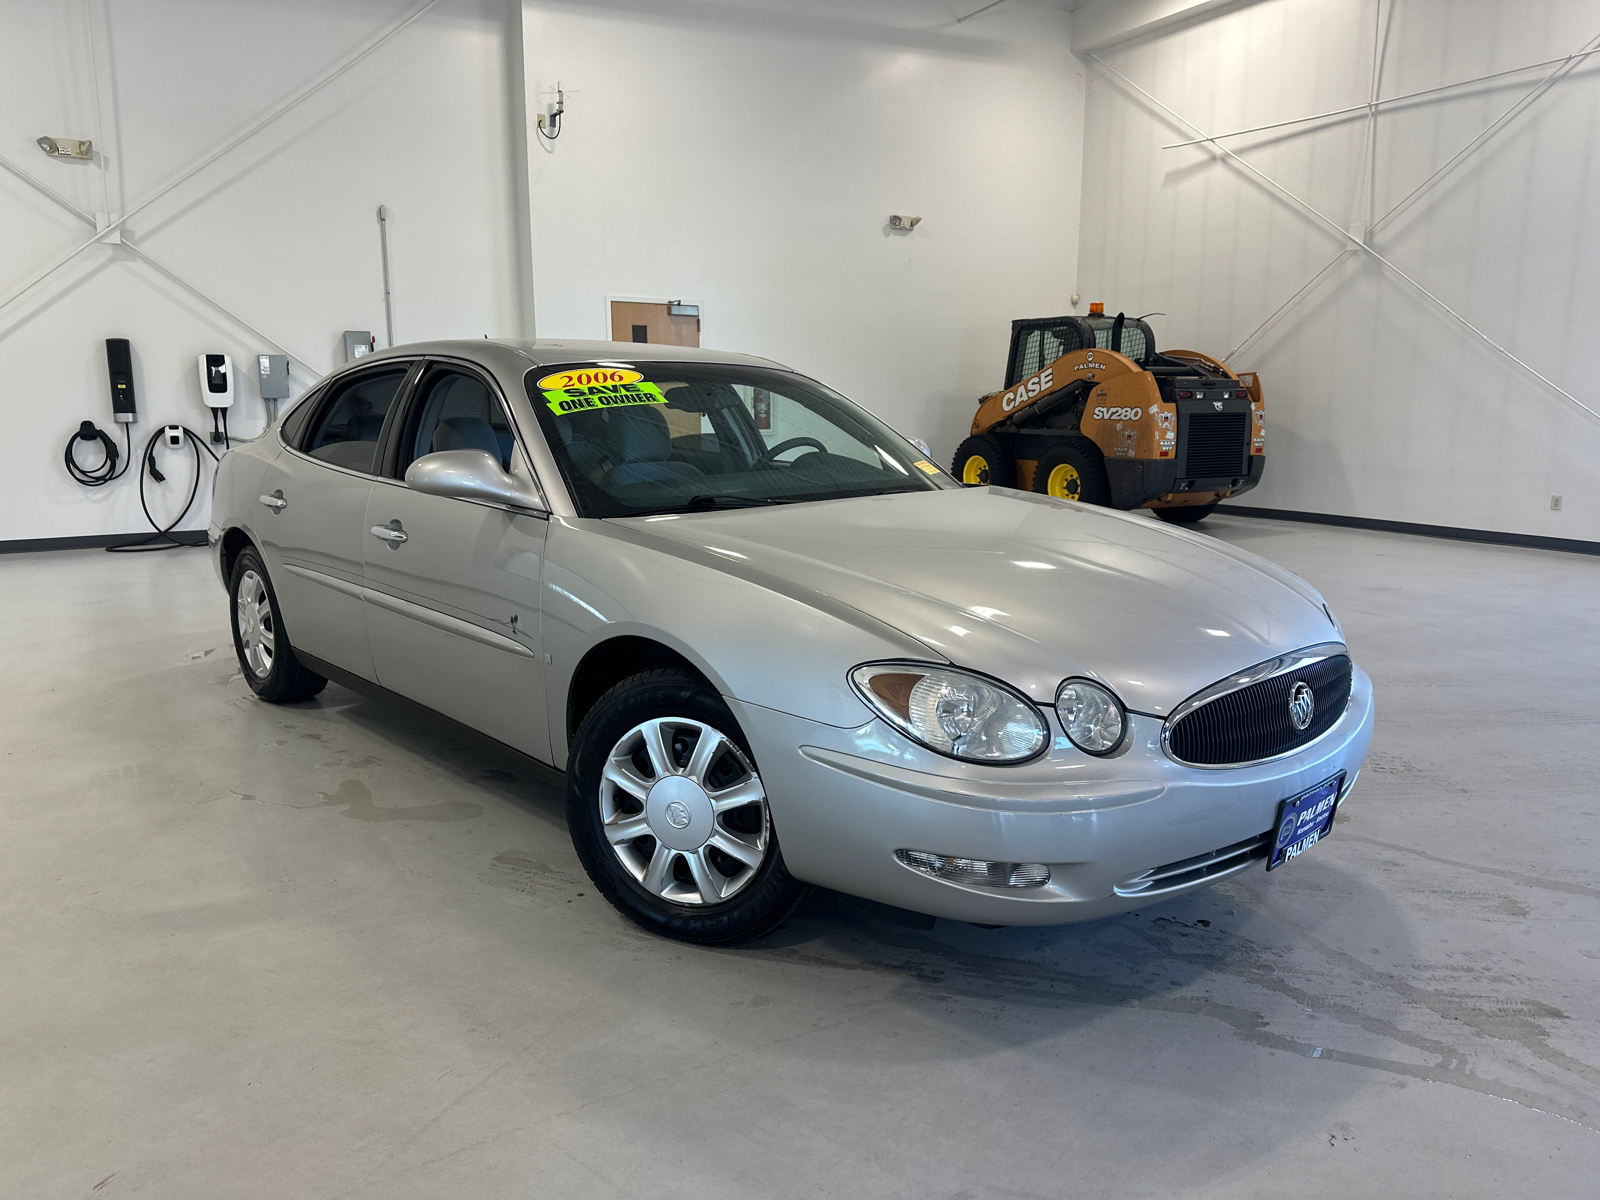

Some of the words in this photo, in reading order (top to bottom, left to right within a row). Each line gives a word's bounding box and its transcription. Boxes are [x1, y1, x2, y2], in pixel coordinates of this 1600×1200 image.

[1074, 362, 1106, 371] PALMEN
[560, 371, 624, 388] 2006
[563, 383, 641, 397] SAVE
[1002, 367, 1053, 412] CASE
[558, 397, 598, 412] ONE
[598, 393, 659, 406] OWNER
[1093, 406, 1142, 420] SV280
[1297, 791, 1338, 826] PALMEN
[1285, 829, 1321, 862] PALMEN
